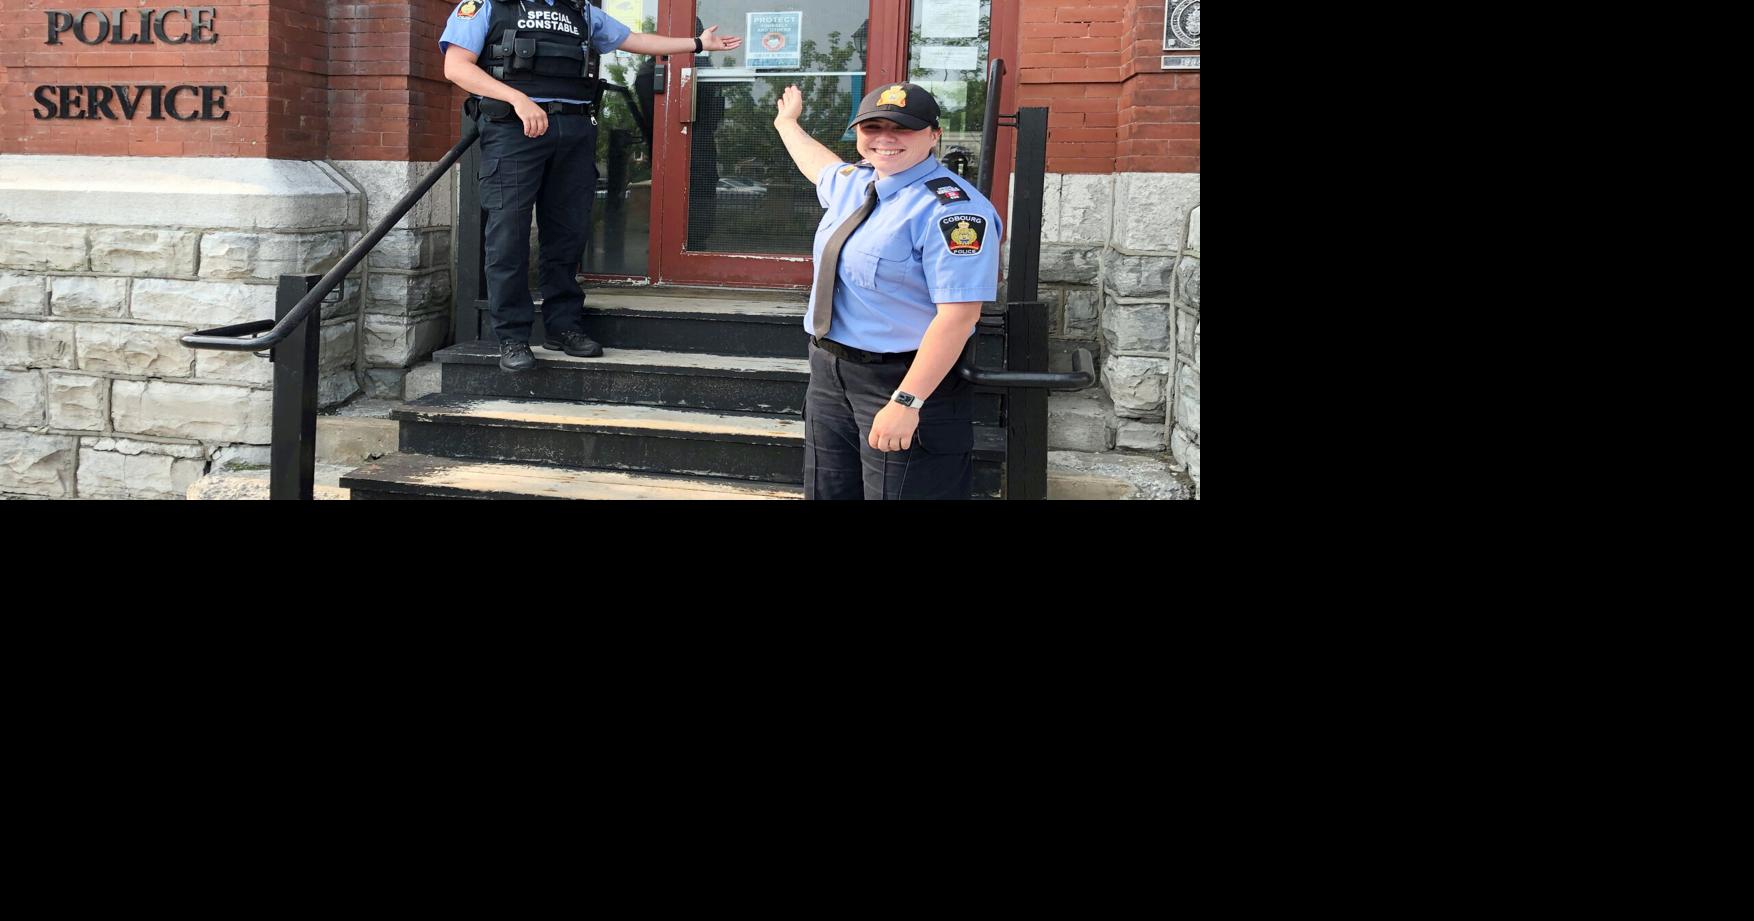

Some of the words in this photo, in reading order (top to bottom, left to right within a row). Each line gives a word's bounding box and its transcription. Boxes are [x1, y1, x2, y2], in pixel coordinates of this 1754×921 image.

[527, 10, 572, 24] SPECIAL
[44, 8, 219, 45] POLICE
[517, 19, 580, 35] CONSTABLE
[33, 85, 230, 121] SERVICE
[943, 215, 981, 224] COBOURG
